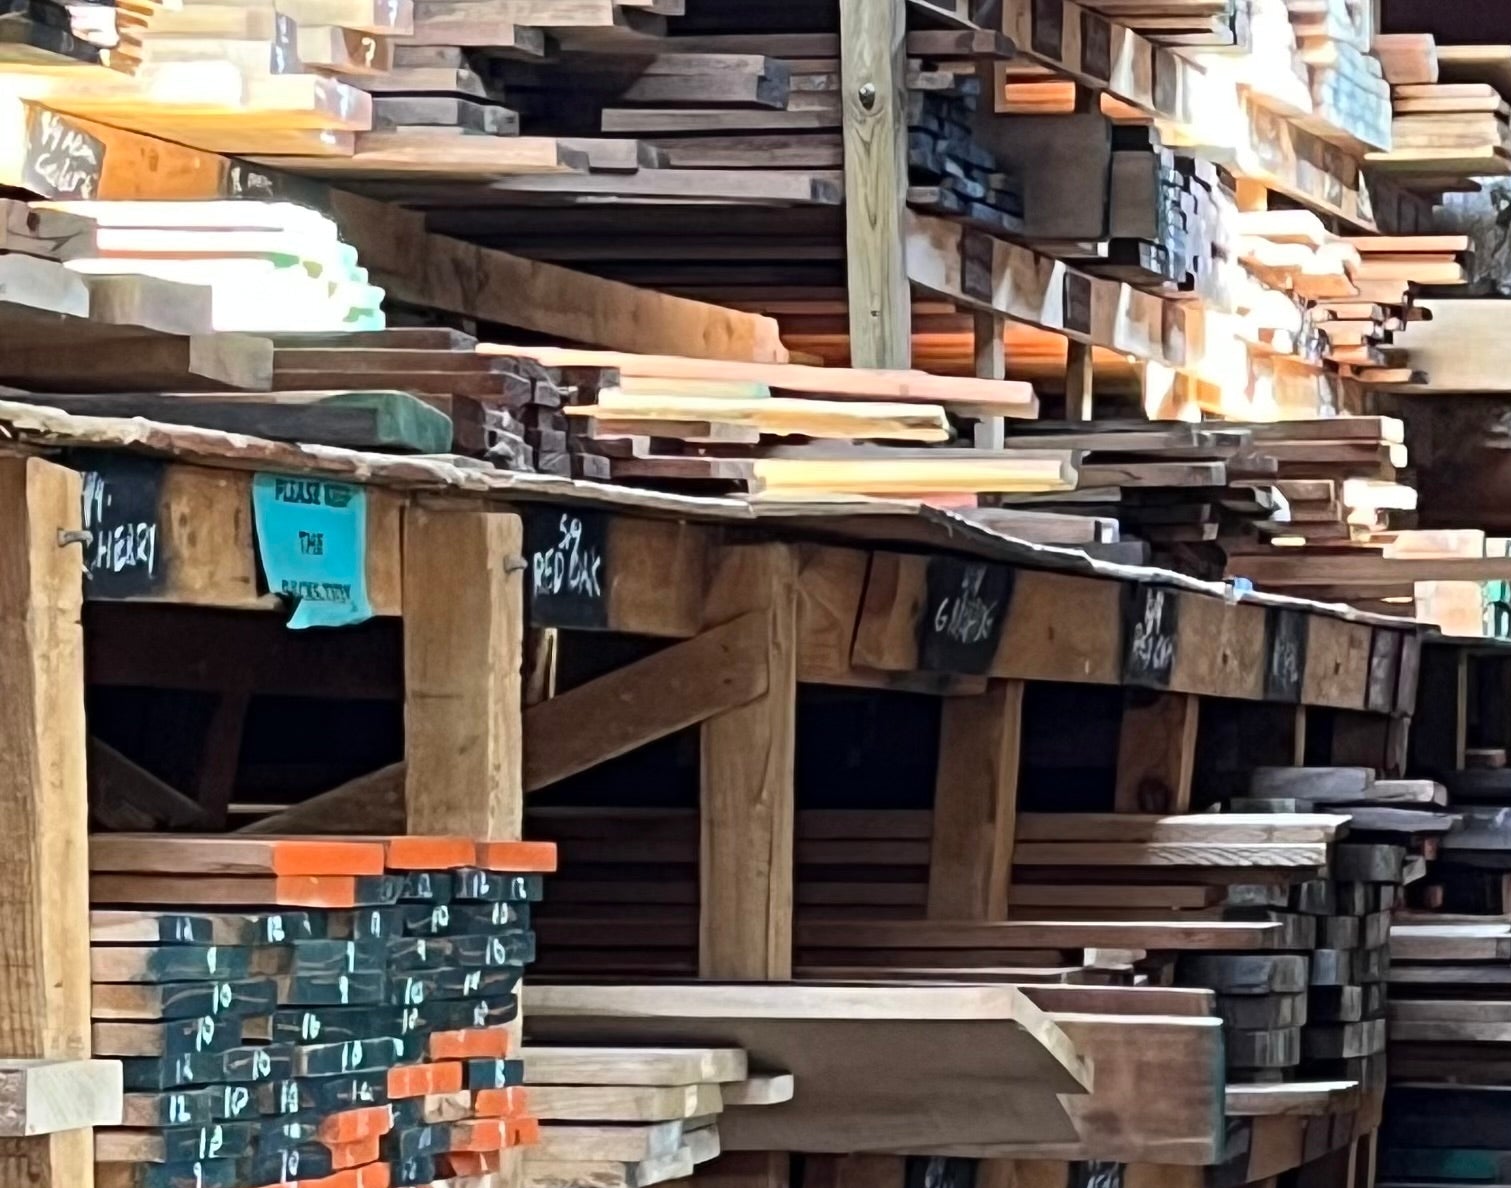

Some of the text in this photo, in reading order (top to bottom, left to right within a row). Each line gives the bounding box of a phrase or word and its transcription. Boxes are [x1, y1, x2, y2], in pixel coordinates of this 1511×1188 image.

[533, 548, 565, 597] RED
[169, 1095, 192, 1123] 12
[224, 1086, 249, 1119] 10
